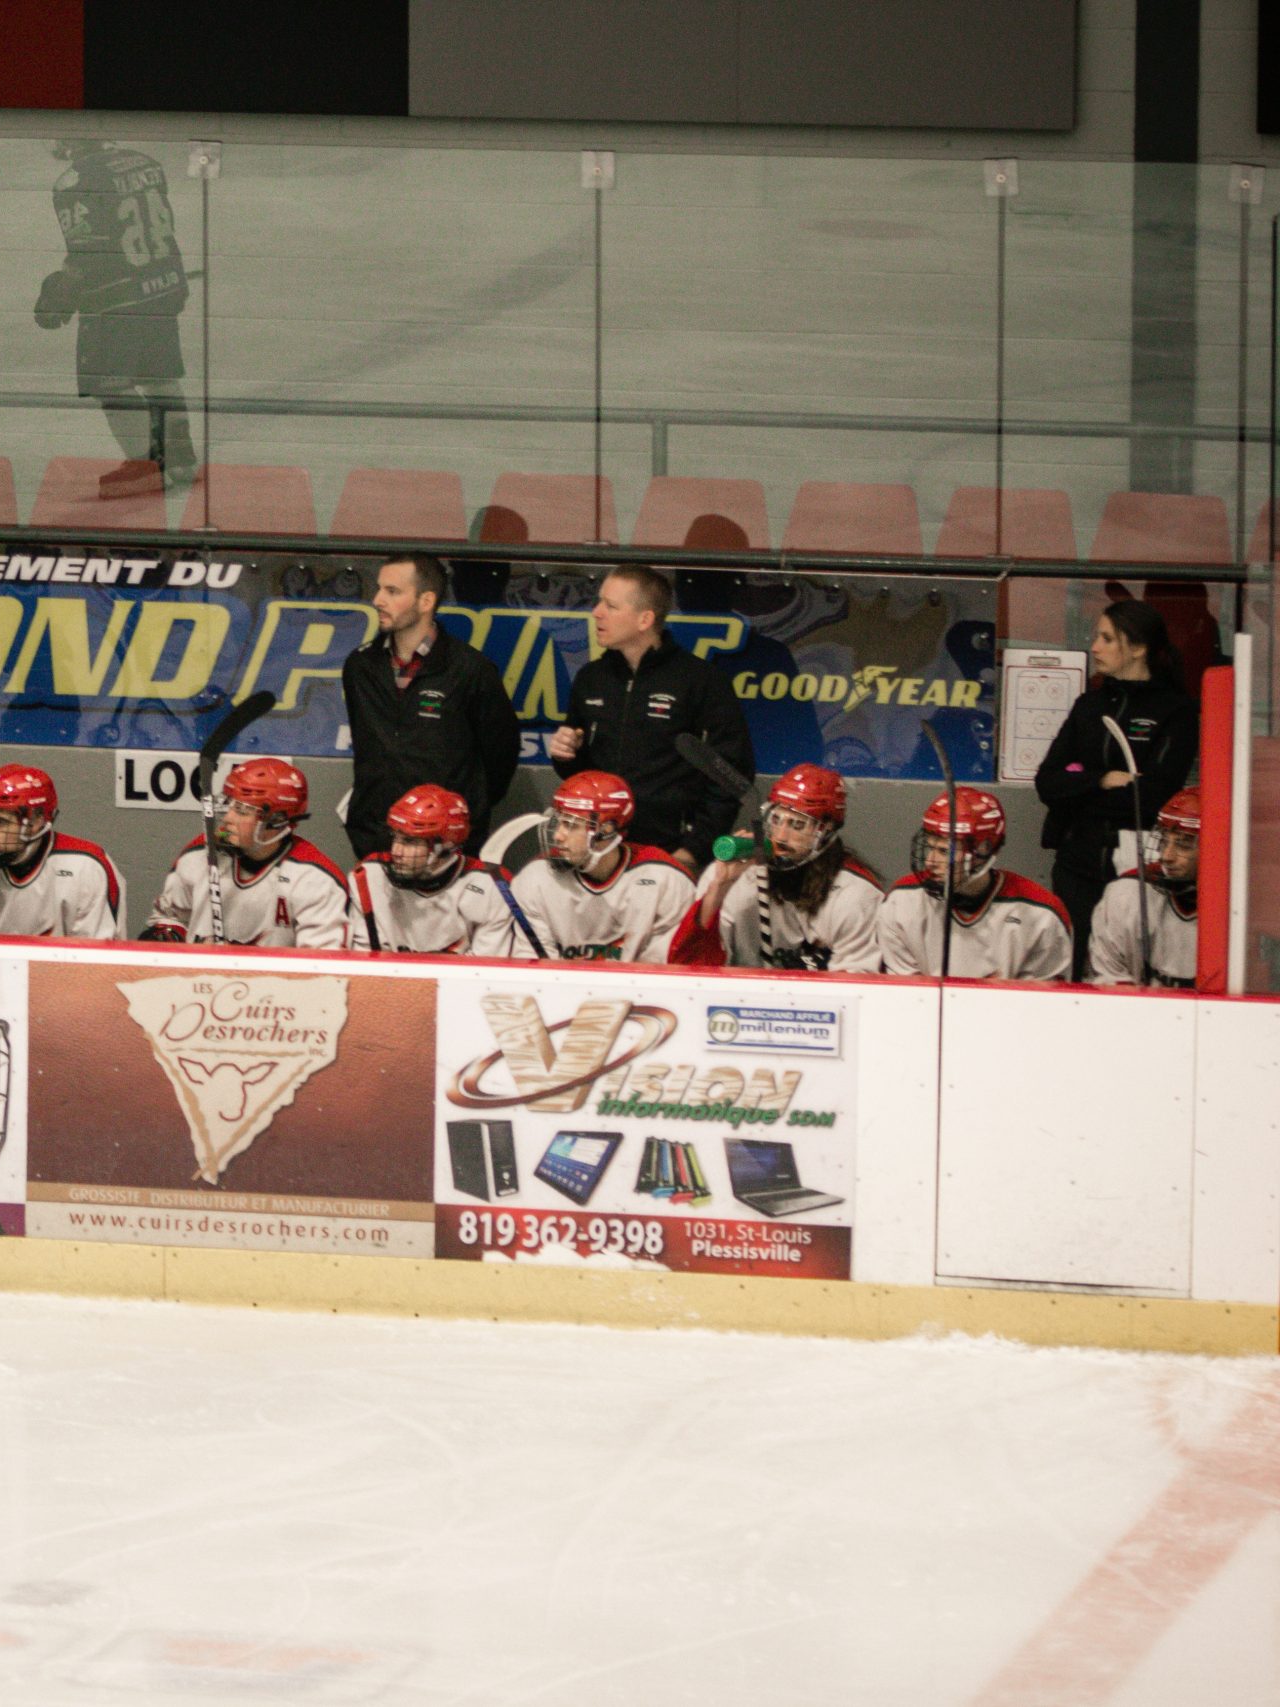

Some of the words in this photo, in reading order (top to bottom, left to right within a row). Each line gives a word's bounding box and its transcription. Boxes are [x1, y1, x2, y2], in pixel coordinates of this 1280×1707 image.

[167, 562, 243, 588] DU
[275, 896, 291, 928] A
[193, 983, 214, 995] LES
[210, 980, 296, 1022] Cuirs
[739, 1009, 795, 1020] MARCHAND
[159, 1001, 328, 1045] Desrochers
[740, 1022, 830, 1037] millenium
[596, 1089, 779, 1130] informatique
[787, 1109, 838, 1129] SDM
[149, 1192, 249, 1210] DISTRIBUTEUR
[252, 1197, 268, 1210] ET
[270, 1198, 391, 1217] MANUFACTURIER
[69, 1212, 390, 1243] www.cuirsdesrochers.com
[458, 1211, 516, 1246] 819
[521, 1214, 664, 1255] 362-9398
[683, 1220, 734, 1240] 1031,
[735, 1224, 813, 1245] St-Louis
[691, 1239, 802, 1262] Plessisville
